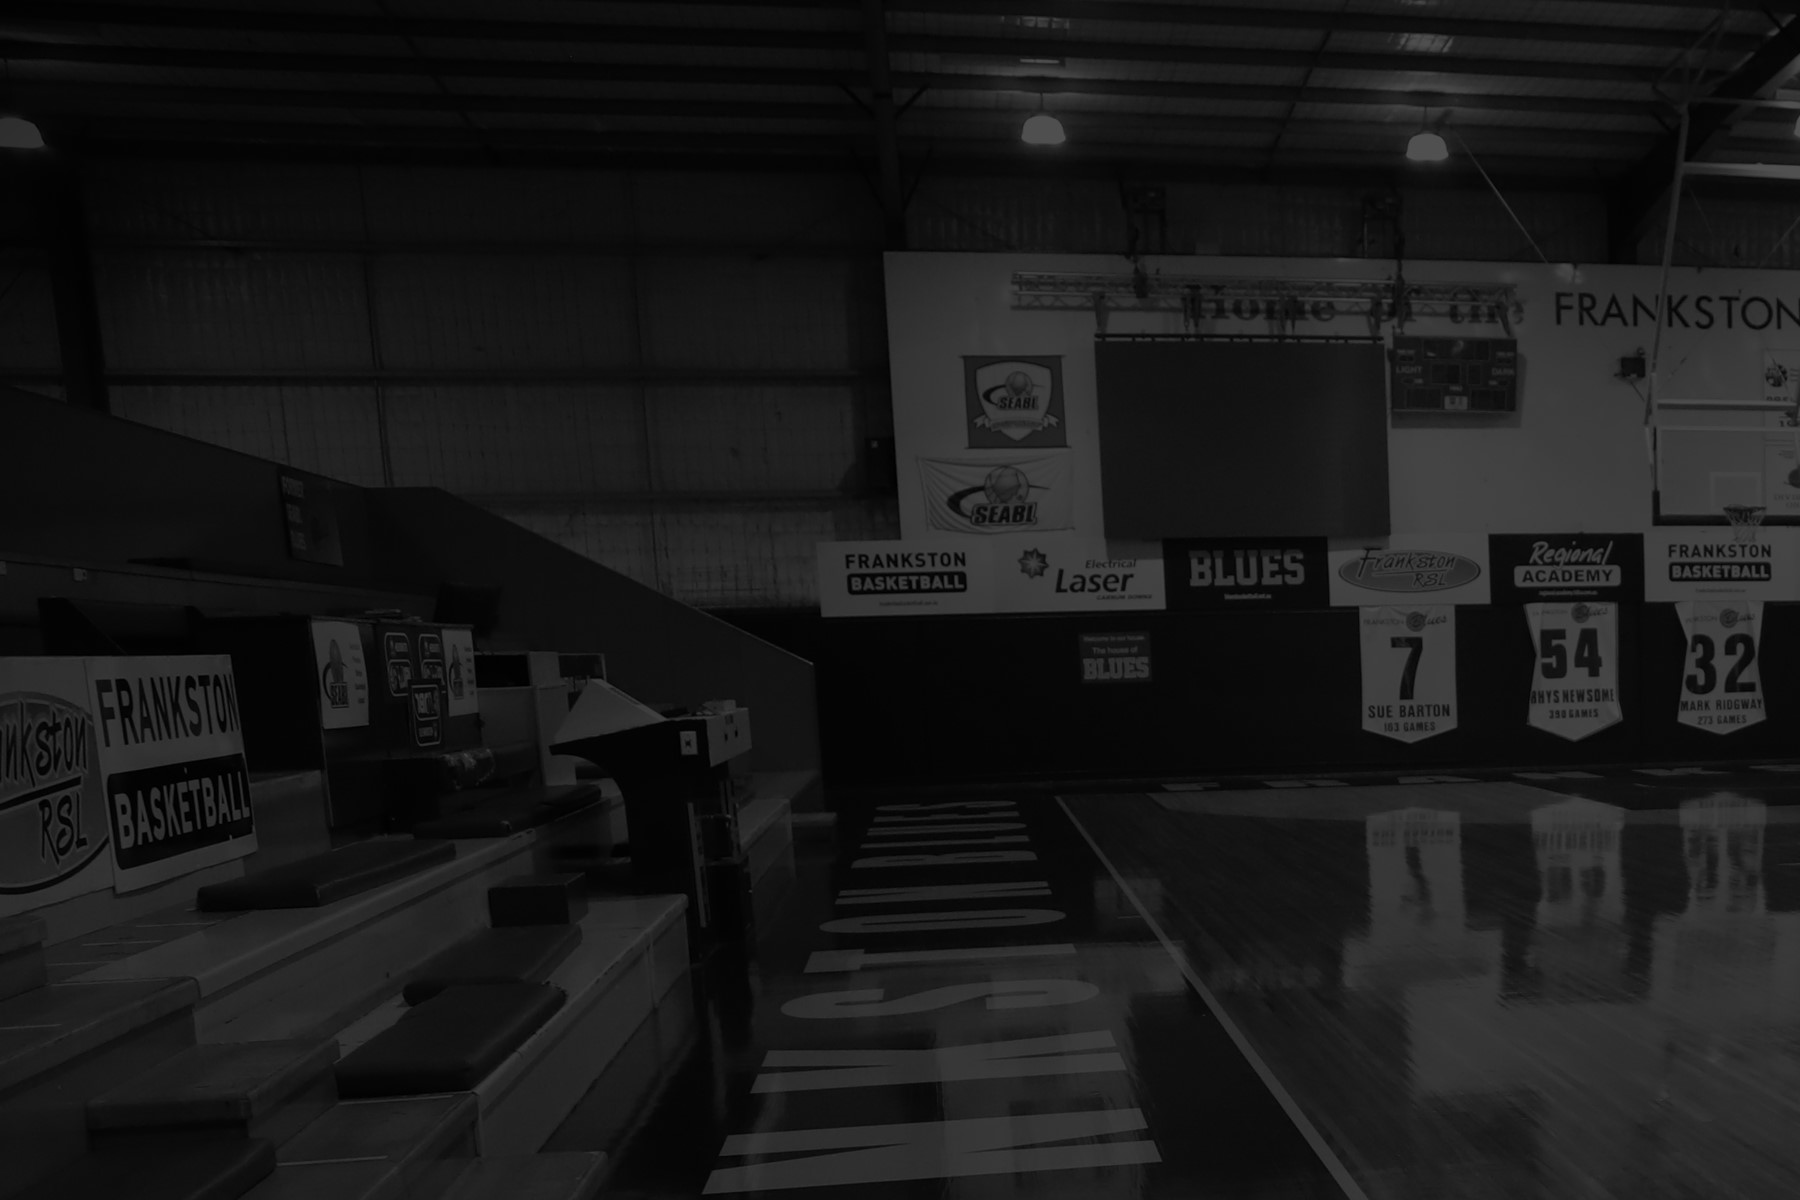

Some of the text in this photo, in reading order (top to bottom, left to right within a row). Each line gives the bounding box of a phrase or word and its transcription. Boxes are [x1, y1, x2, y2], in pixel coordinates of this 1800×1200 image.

[998, 396, 1039, 410] SEABL
[972, 503, 1037, 525] SEABL
[1528, 539, 1614, 570] Regional
[1667, 544, 1772, 558] FRANKSTON
[845, 552, 966, 569] FRANKSTON
[1085, 558, 1137, 569] Electrical
[1188, 549, 1306, 587] BLUES
[1358, 547, 1457, 580] Frankston
[1411, 572, 1448, 588] RSL
[1521, 569, 1614, 583] ACADEMY
[1670, 564, 1770, 579] BASKETBALL
[850, 574, 966, 591] BASKETBALL
[1055, 568, 1134, 594] Laser
[1540, 628, 1603, 679] 54
[1082, 656, 1149, 681] BLUES
[1391, 636, 1423, 700] 7
[1685, 633, 1757, 695] 32
[1530, 687, 1615, 705] RHYS NEWSOME
[95, 673, 240, 748] FRANKSTON
[1368, 703, 1451, 719] SUE BARTON
[1568, 708, 1600, 719] GAMES
[1680, 699, 1763, 713] MARK RIDGWAY
[1403, 721, 1436, 732] GAMES
[1697, 714, 1748, 726] 273 GAMES
[0, 700, 89, 788] nkston
[114, 769, 251, 850] BASKETBALL
[38, 792, 89, 865] RSL
